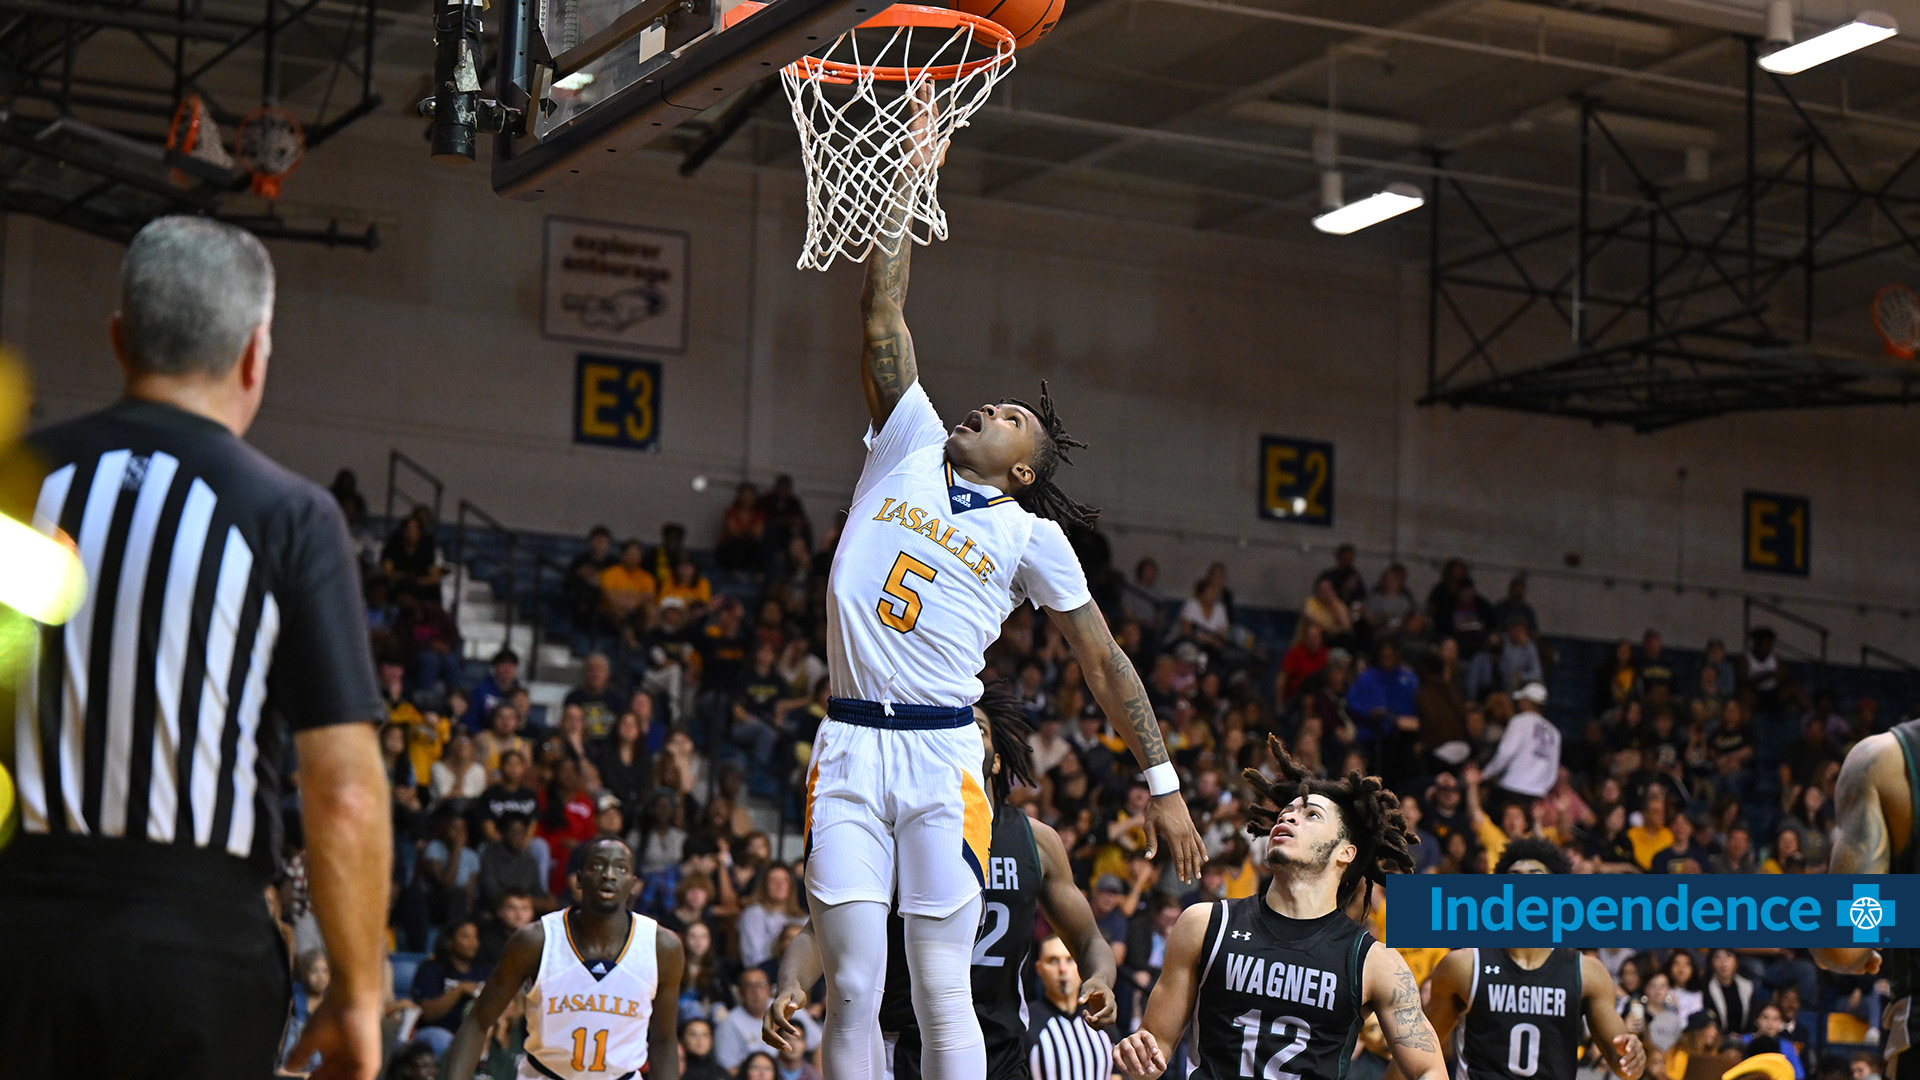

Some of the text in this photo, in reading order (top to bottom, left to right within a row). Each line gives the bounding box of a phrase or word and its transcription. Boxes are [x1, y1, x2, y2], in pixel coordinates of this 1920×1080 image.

[582, 364, 653, 441] E3
[1266, 444, 1327, 516] E2
[873, 498, 996, 586] LASALLE
[1749, 500, 1804, 569] E1
[876, 551, 938, 634] 5
[547, 994, 640, 1017] LASALLE
[1225, 953, 1338, 1011] WAGNER
[1488, 984, 1567, 1017] WAGNER
[571, 1027, 609, 1072] 11
[1232, 1008, 1312, 1080] 12
[1508, 1023, 1541, 1077] 0
